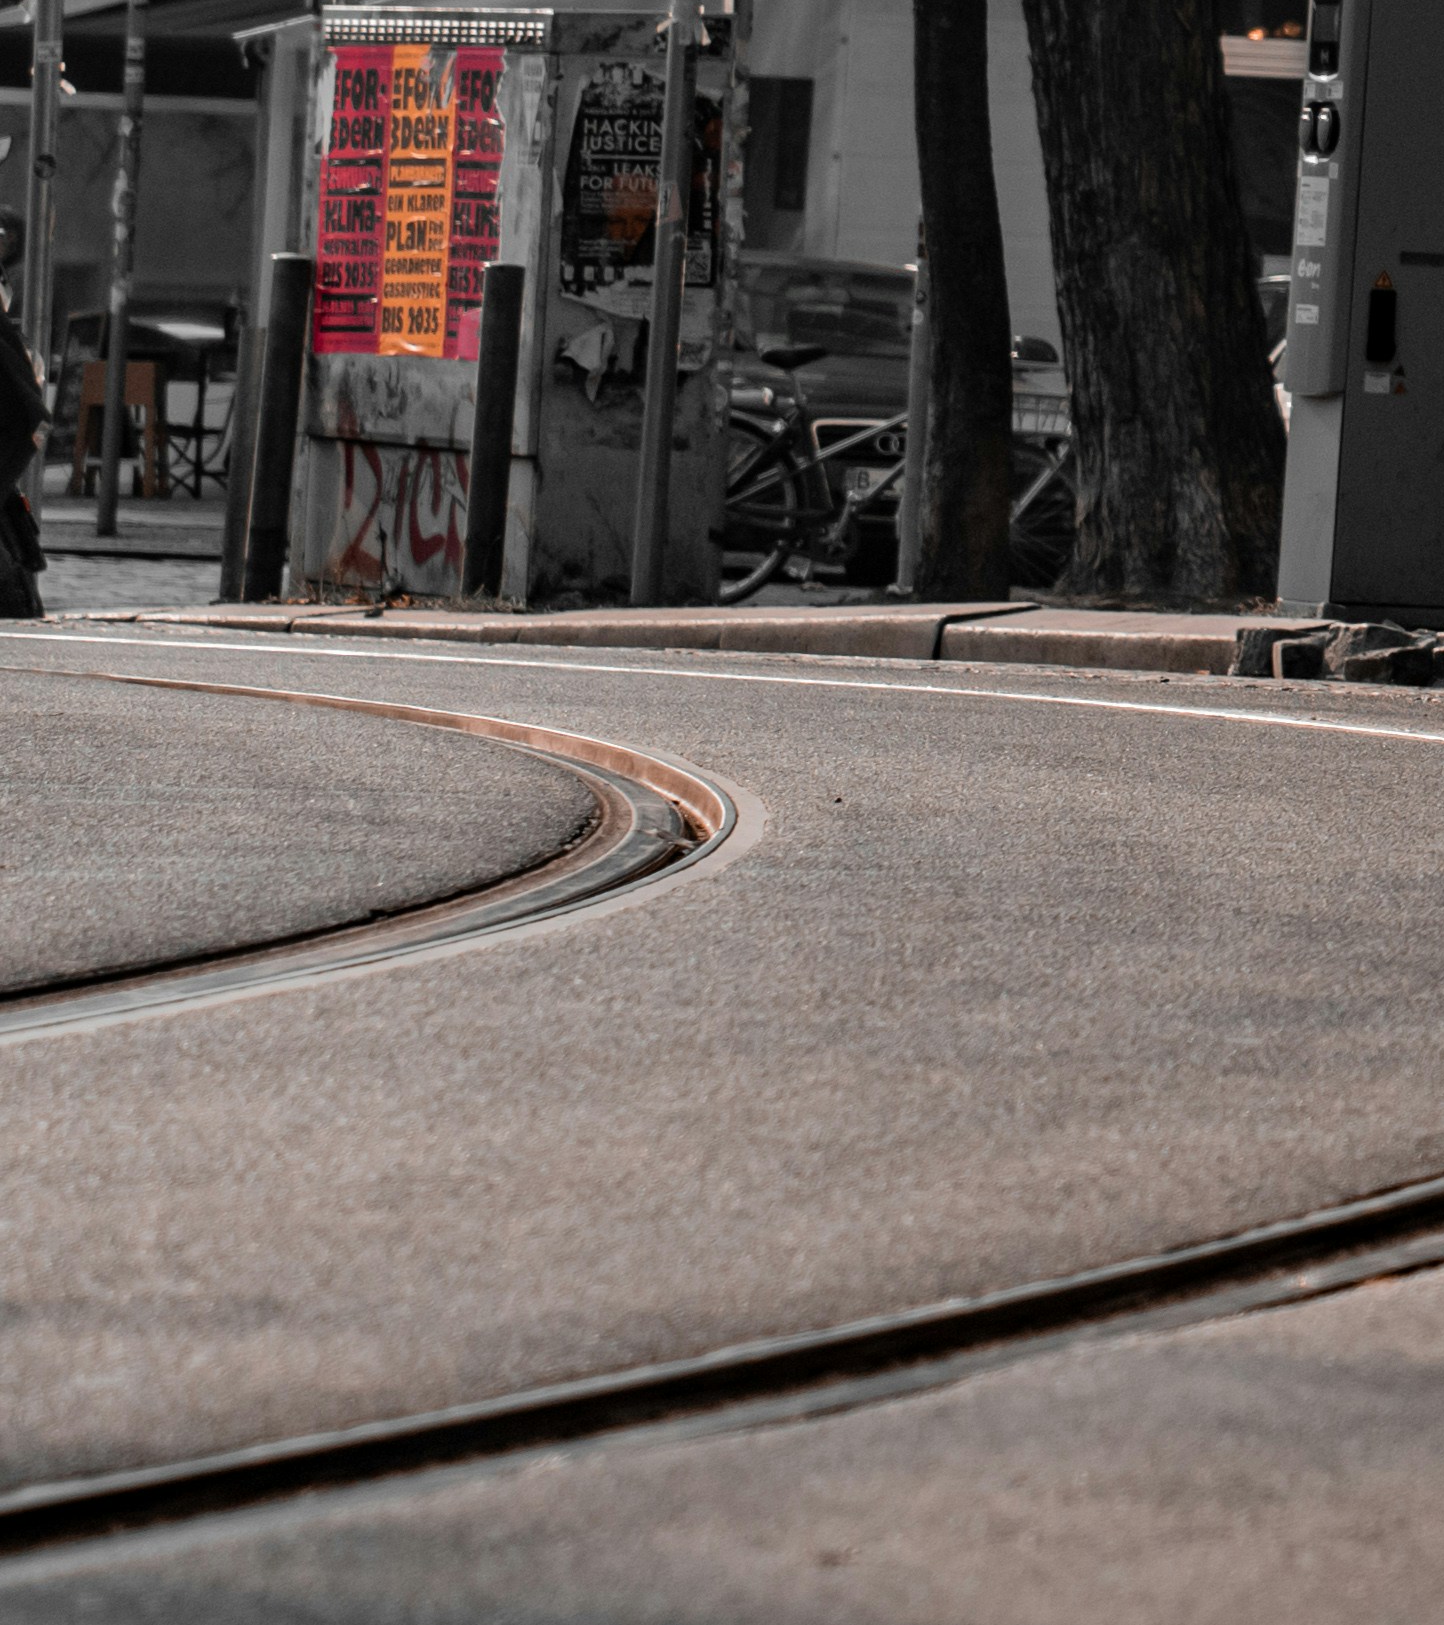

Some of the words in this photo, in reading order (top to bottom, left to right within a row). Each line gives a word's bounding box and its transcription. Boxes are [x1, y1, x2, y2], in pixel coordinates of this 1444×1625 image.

[583, 136, 661, 152] JUSTICE
[382, 306, 404, 334] BIS
[408, 307, 440, 335] 2035
